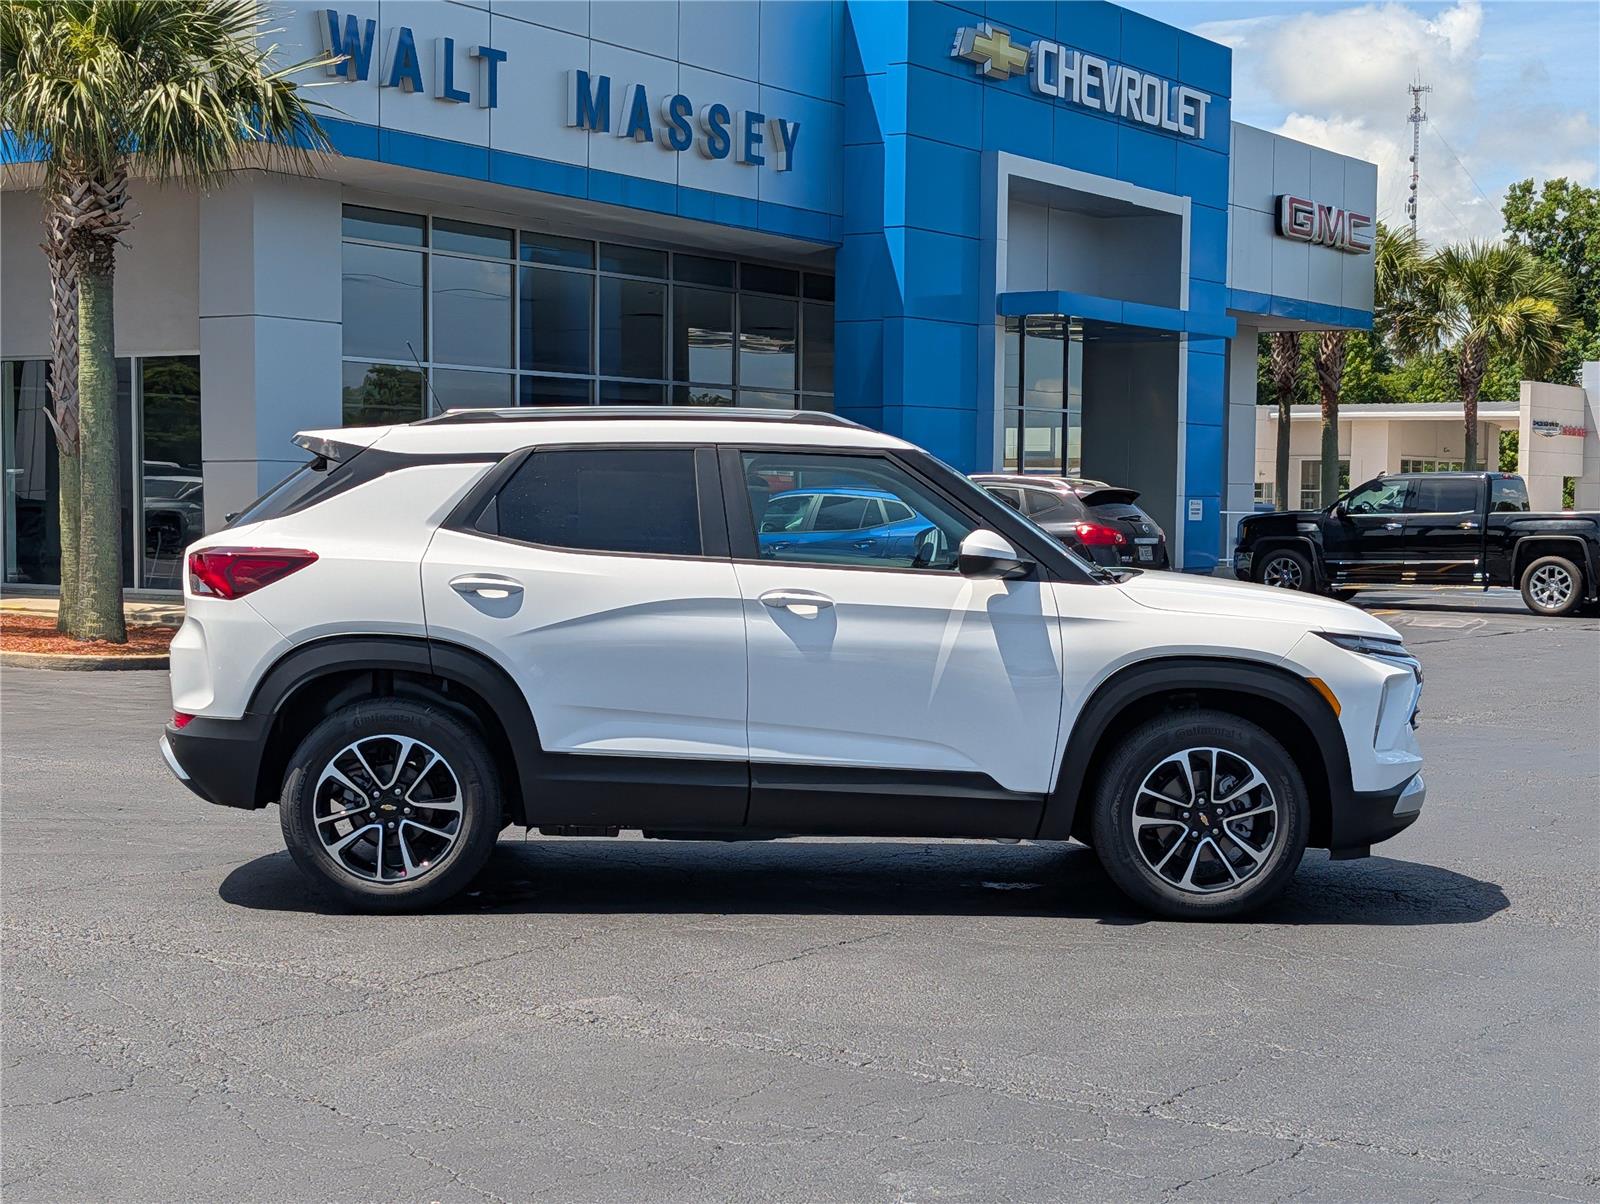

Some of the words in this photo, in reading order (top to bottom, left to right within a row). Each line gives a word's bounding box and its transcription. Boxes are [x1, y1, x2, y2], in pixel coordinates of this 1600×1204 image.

[317, 8, 507, 109] WALT
[566, 69, 800, 172] MASSEY
[1033, 39, 1212, 140] CHEVROLET
[1278, 194, 1372, 255] GMC
